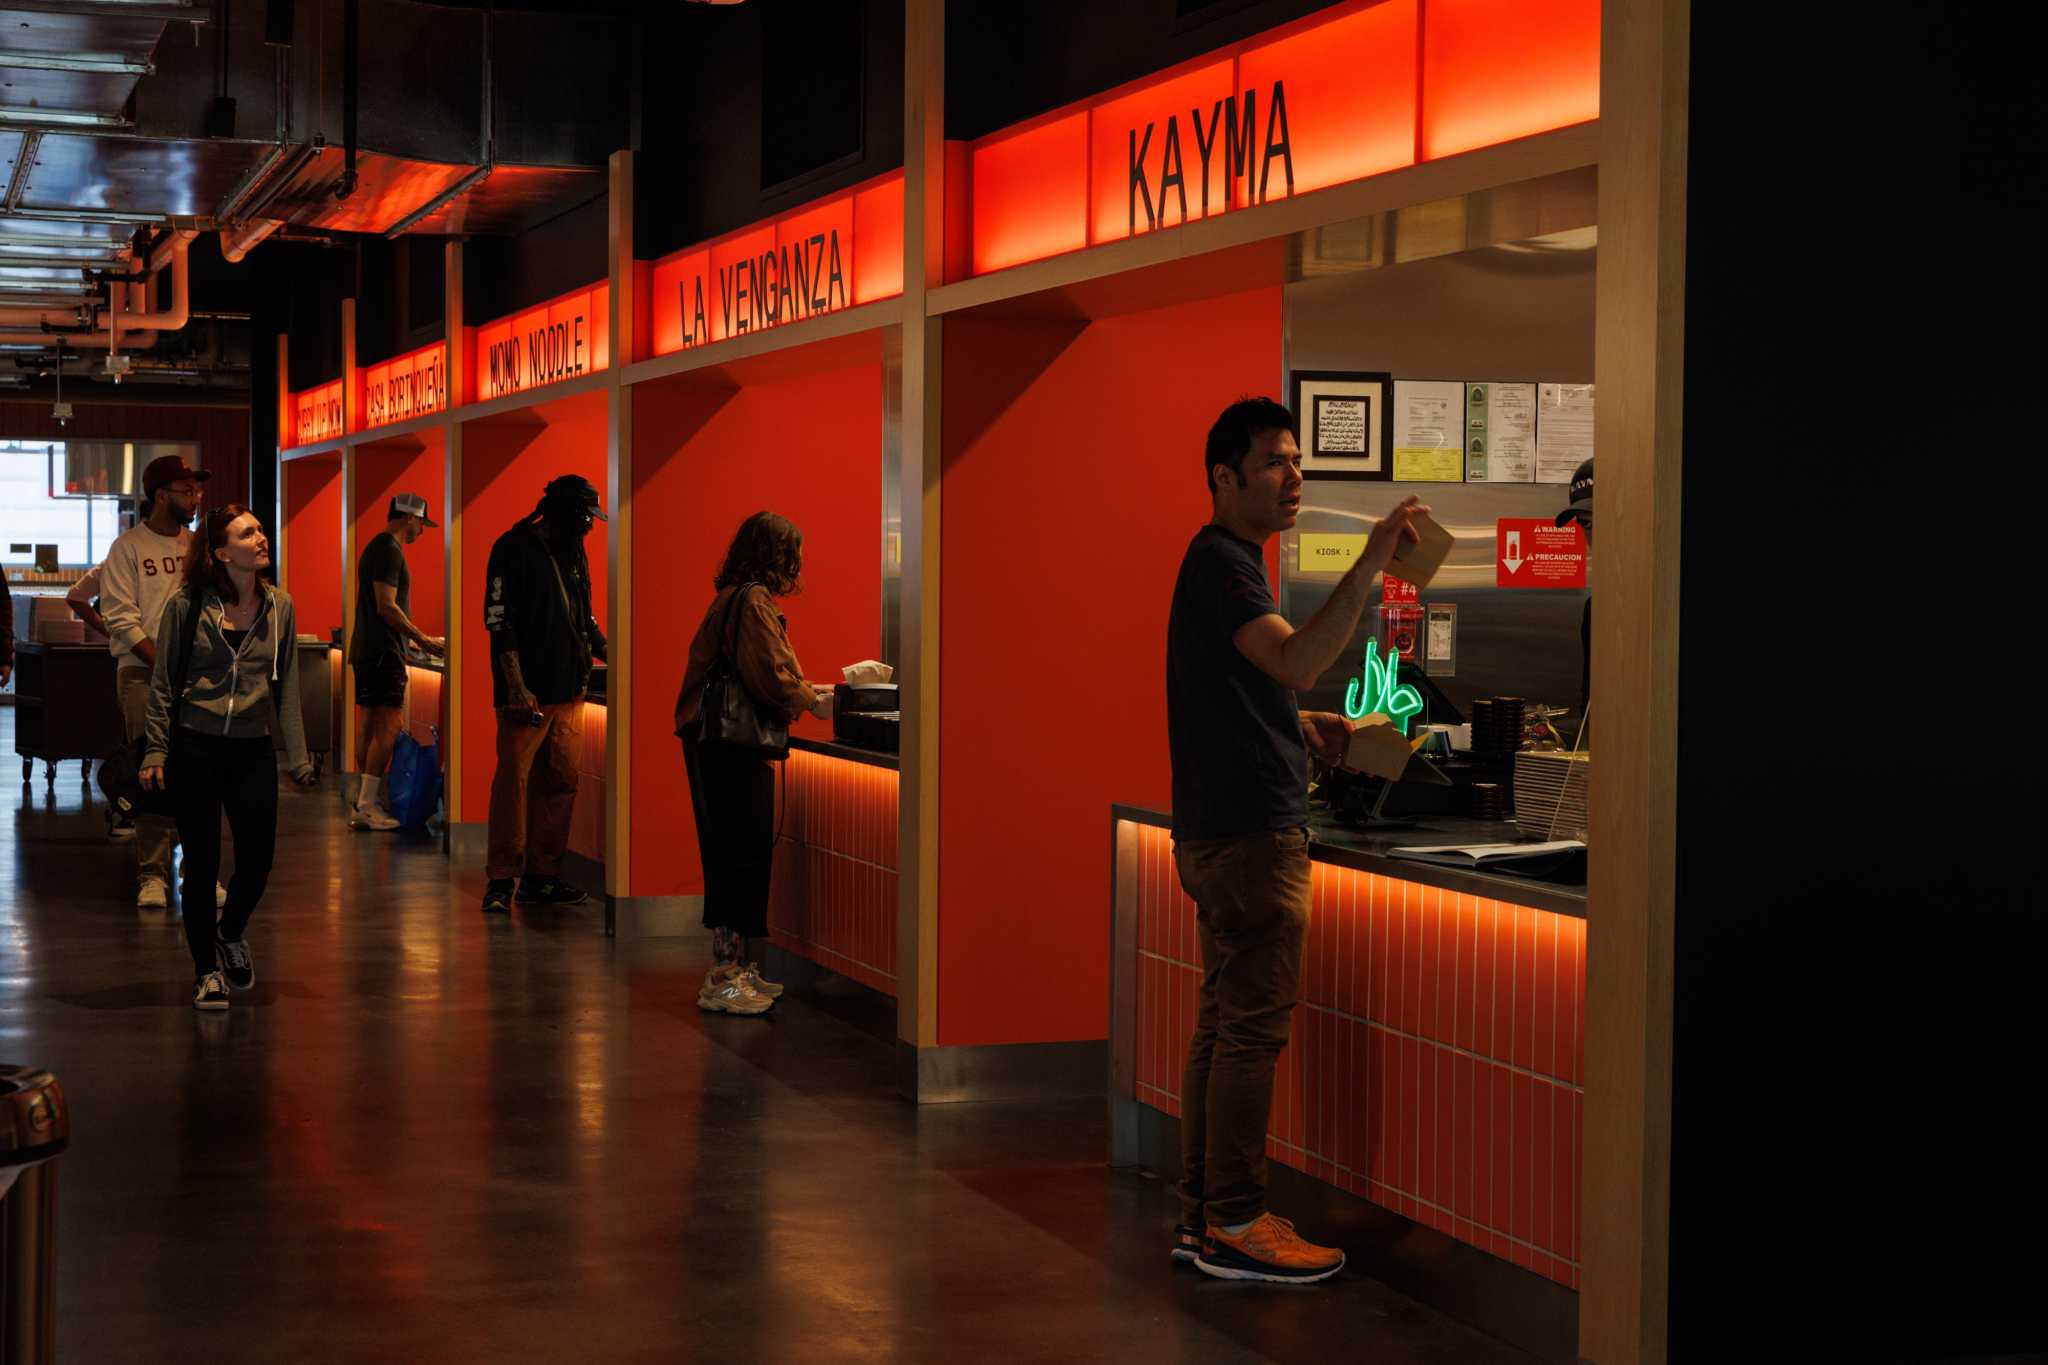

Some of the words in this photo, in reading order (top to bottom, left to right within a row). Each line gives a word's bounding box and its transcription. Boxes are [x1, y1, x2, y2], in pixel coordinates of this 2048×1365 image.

[1129, 80, 1294, 237] KAYMA
[680, 275, 706, 346] LA
[720, 229, 845, 337] VENGANZA
[490, 336, 520, 398] MOMO
[529, 316, 583, 388] NOODLE
[1316, 548, 1341, 556] KIOSK
[1346, 548, 1351, 556] 1
[1400, 582, 1417, 597] #4
[1345, 638, 1420, 719] حلال
